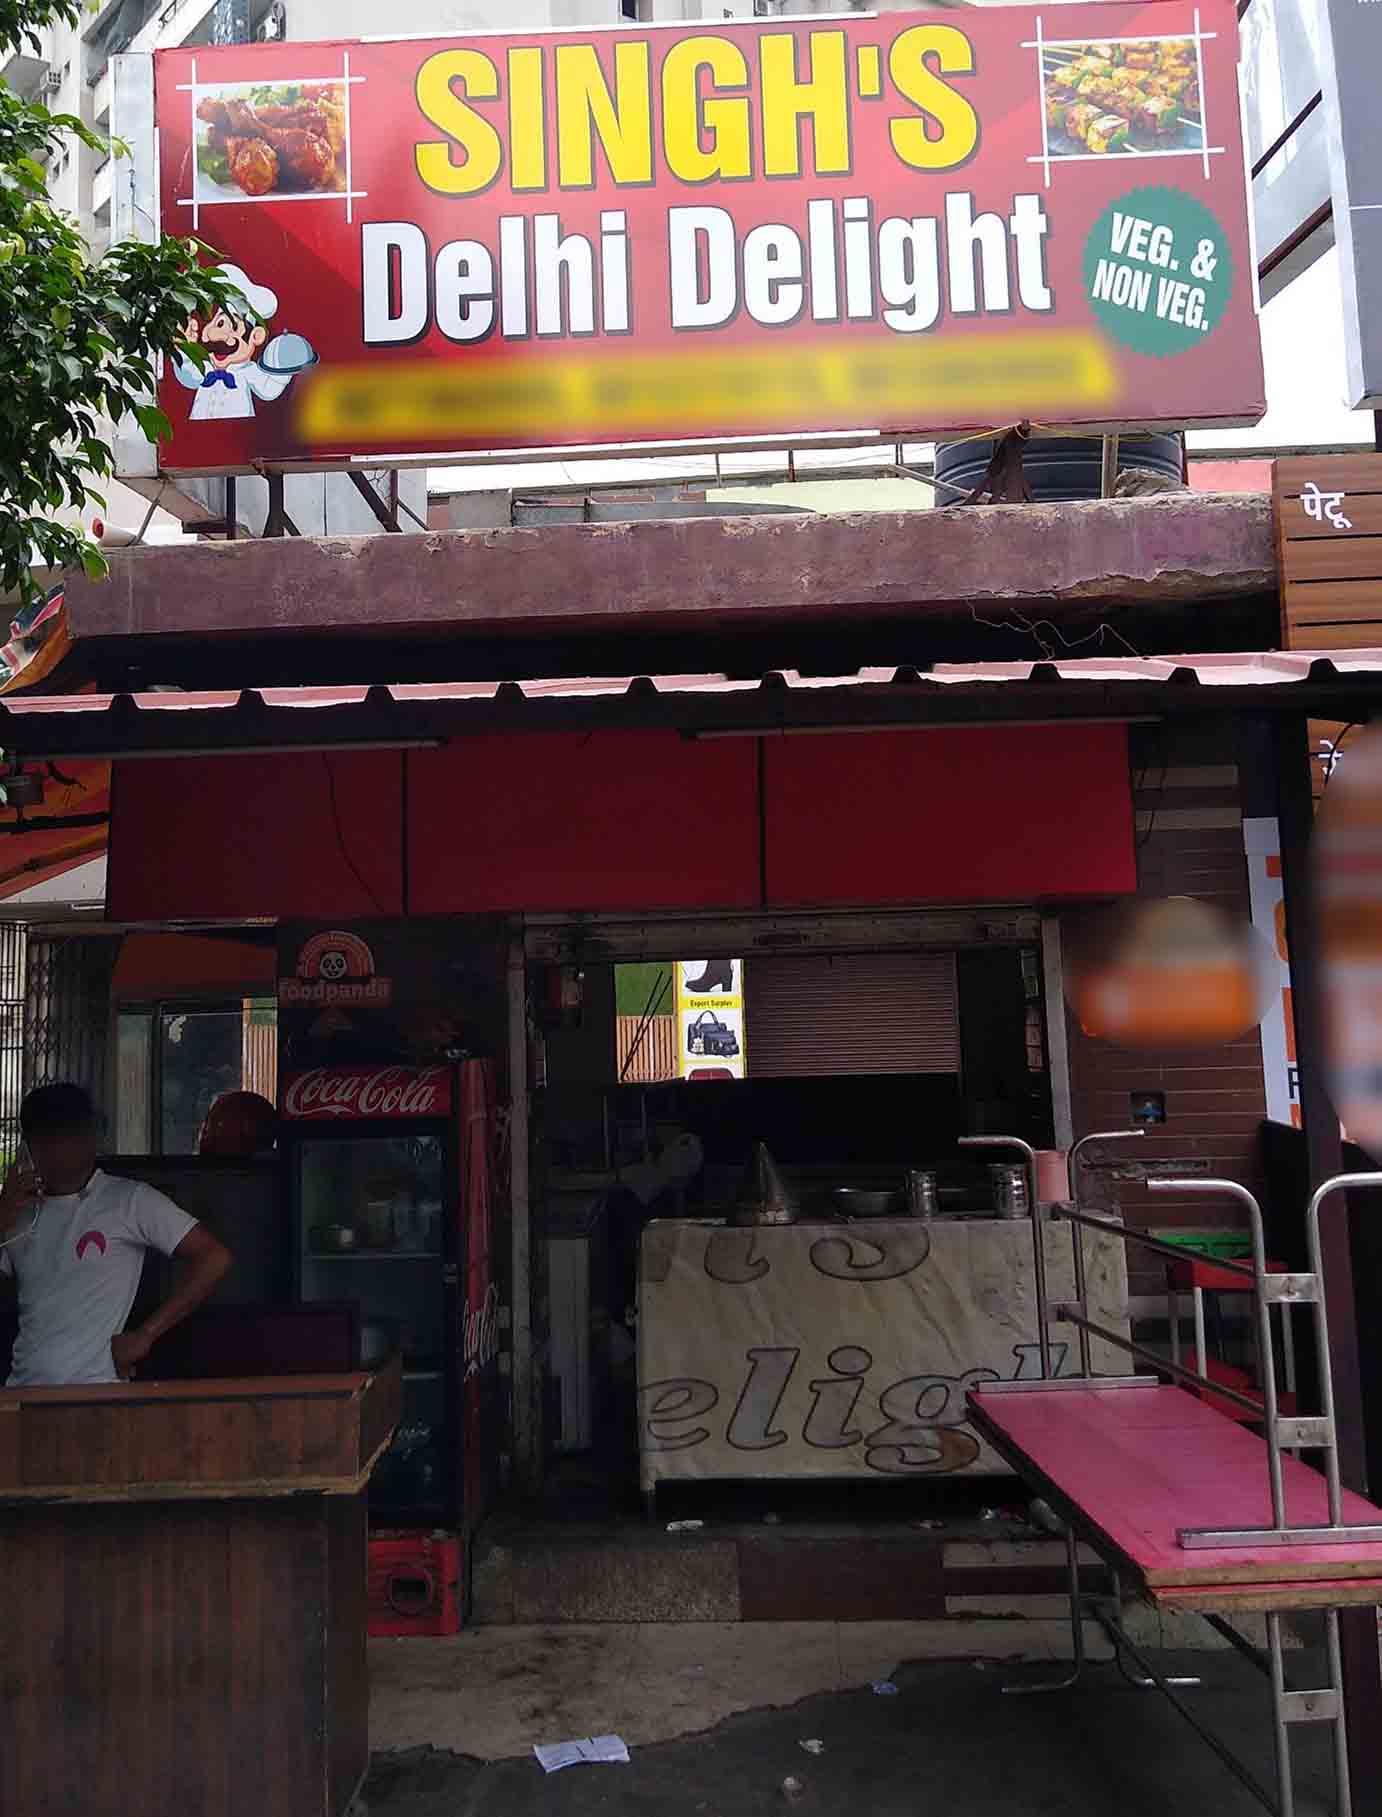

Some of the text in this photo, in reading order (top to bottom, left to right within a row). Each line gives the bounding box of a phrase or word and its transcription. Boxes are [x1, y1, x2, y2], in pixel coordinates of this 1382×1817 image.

[414, 24, 979, 194] SINGH'S
[361, 191, 1055, 345] Delhi Delight
[1091, 258, 1209, 331] NON VEG.
[1110, 211, 1217, 281] VEG. &
